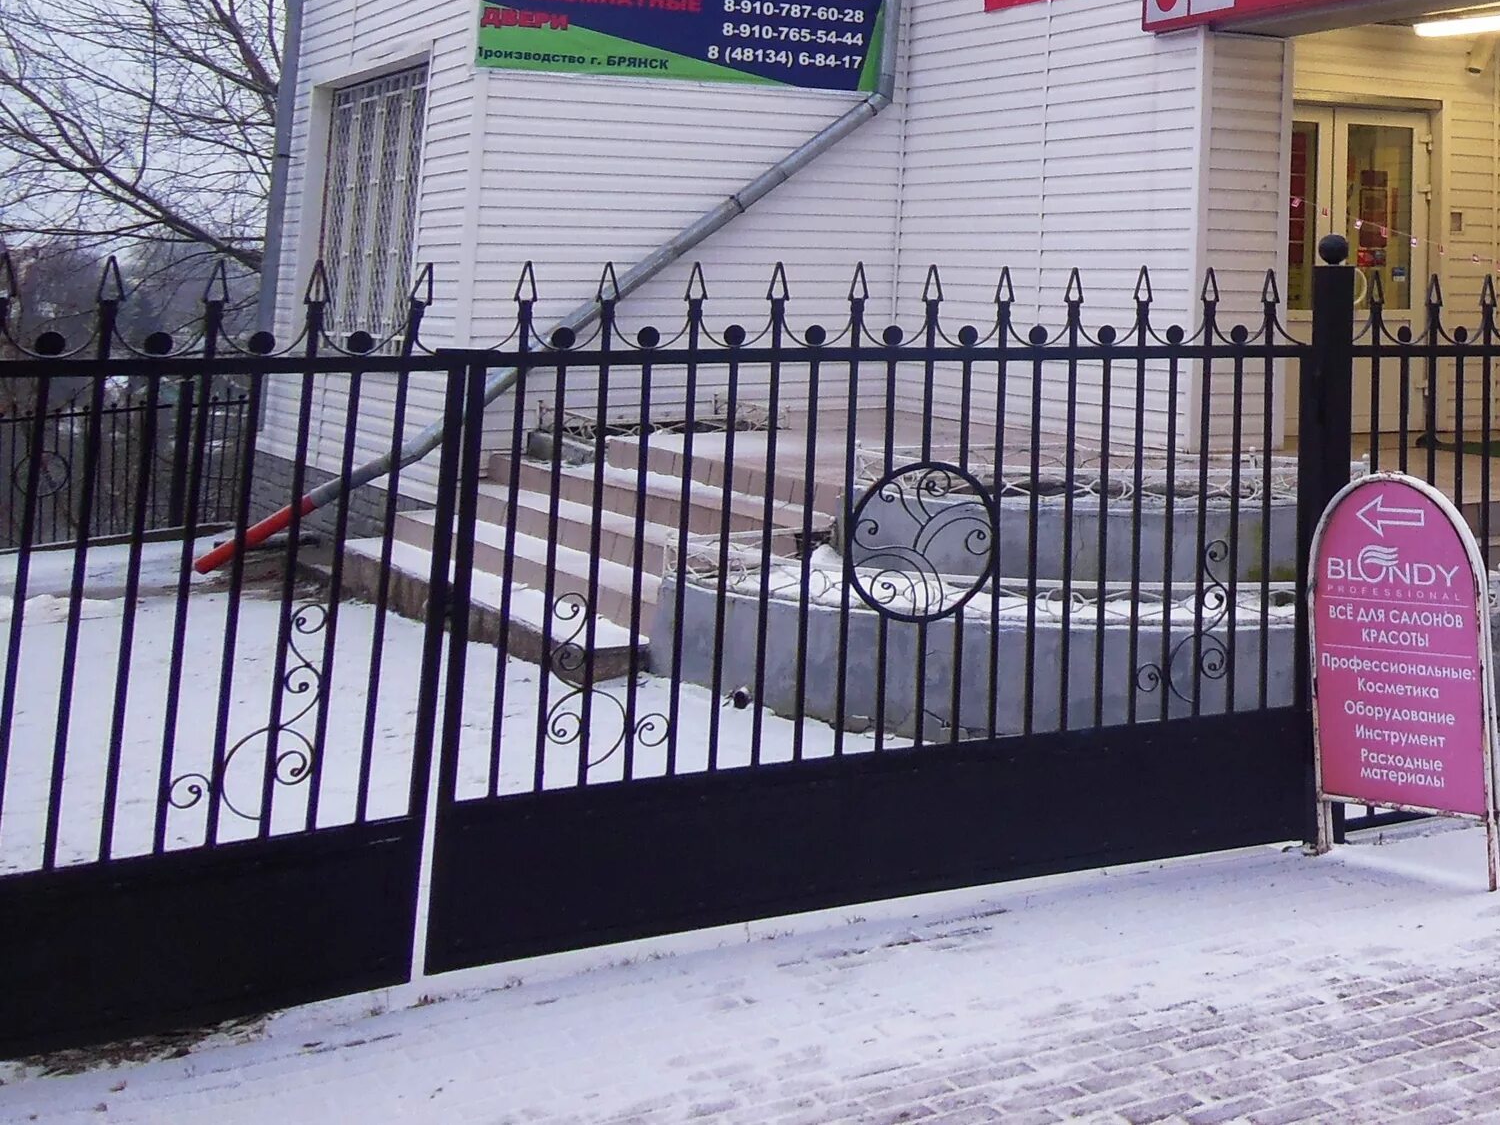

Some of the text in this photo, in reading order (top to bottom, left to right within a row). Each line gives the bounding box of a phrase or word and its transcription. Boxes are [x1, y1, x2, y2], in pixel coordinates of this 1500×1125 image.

[481, 7, 570, 31] ДВЕРИ
[722, 22, 864, 46] 8-910-765-54-44
[589, 56, 601, 66] г.
[606, 55, 670, 70] БРЯНСК
[707, 45, 863, 69] 8 (48134) 6-84-17
[1327, 544, 1460, 587] BLONDY
[1327, 584, 1460, 601] PROFESSIONAL
[1329, 603, 1464, 628] ВСЁ ДЛЯ САЛОНОВ
[1361, 628, 1429, 647] КРАСОТЫ
[1321, 652, 1476, 681] Профессиональные:
[1357, 677, 1439, 699] Косметика
[1344, 700, 1455, 725] Оборудование
[1355, 724, 1445, 747] Инструмент
[1360, 748, 1443, 771] Расходные
[1360, 766, 1444, 788] материалы
